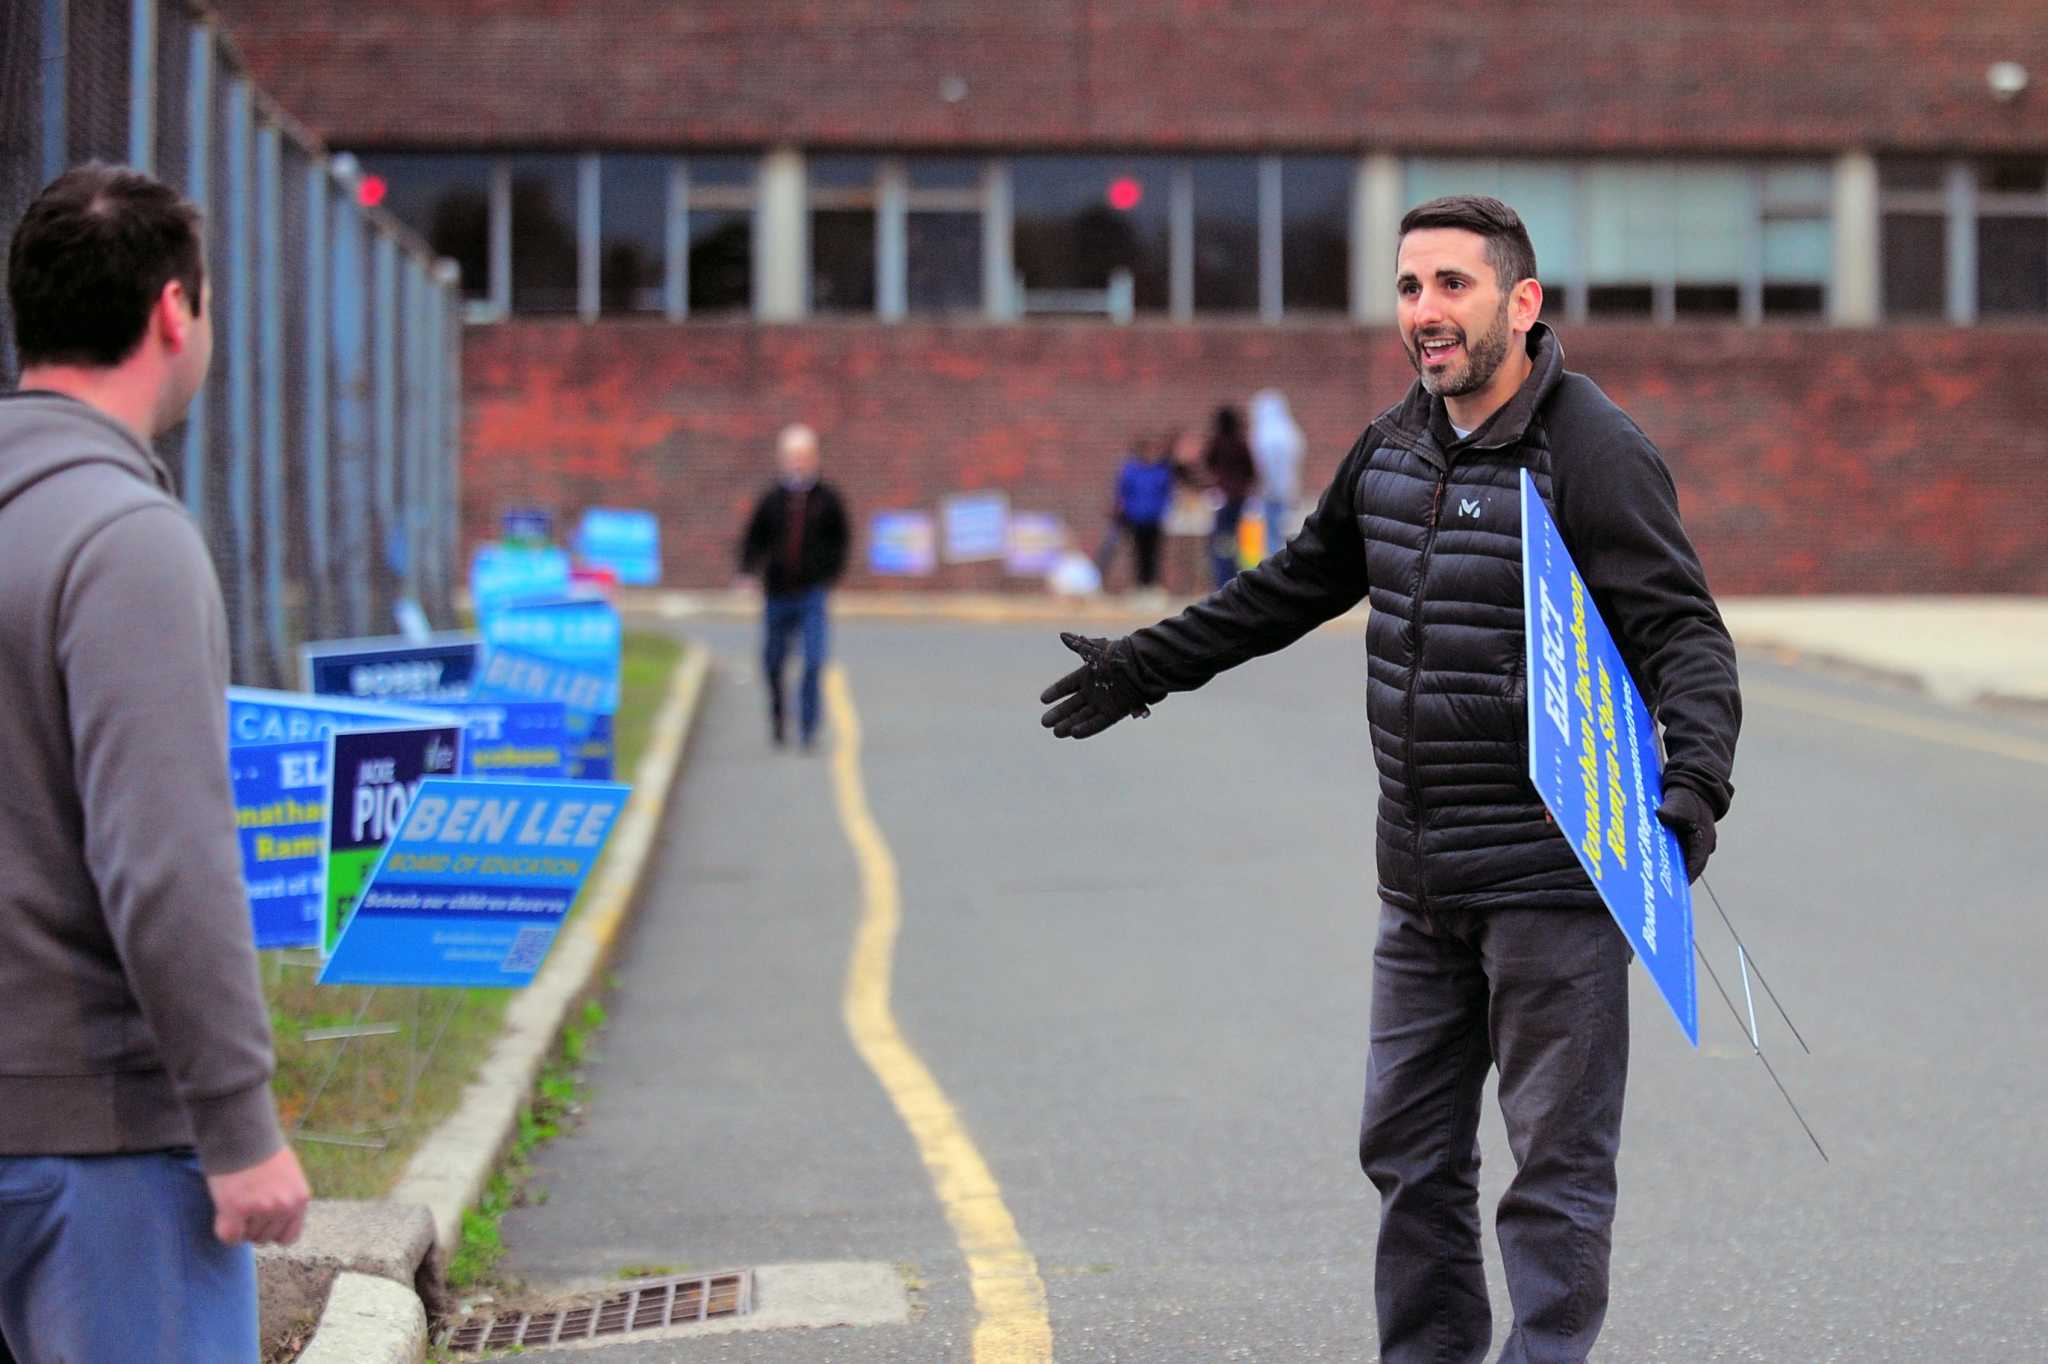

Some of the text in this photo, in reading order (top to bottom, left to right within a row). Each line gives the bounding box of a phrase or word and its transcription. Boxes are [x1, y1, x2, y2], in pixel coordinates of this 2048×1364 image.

[1538, 576, 1571, 747] ELECT
[279, 752, 327, 791] EL
[1599, 656, 1627, 870] Ramya Shaw
[402, 798, 618, 848] BEN LEE
[1580, 716, 1601, 880] Jonathan
[255, 834, 326, 862] Ram
[388, 854, 450, 874] BOARD
[451, 855, 479, 875] OF
[478, 855, 581, 877] EDUCATION
[1638, 836, 1654, 882] of
[1640, 868, 1657, 955] Board
